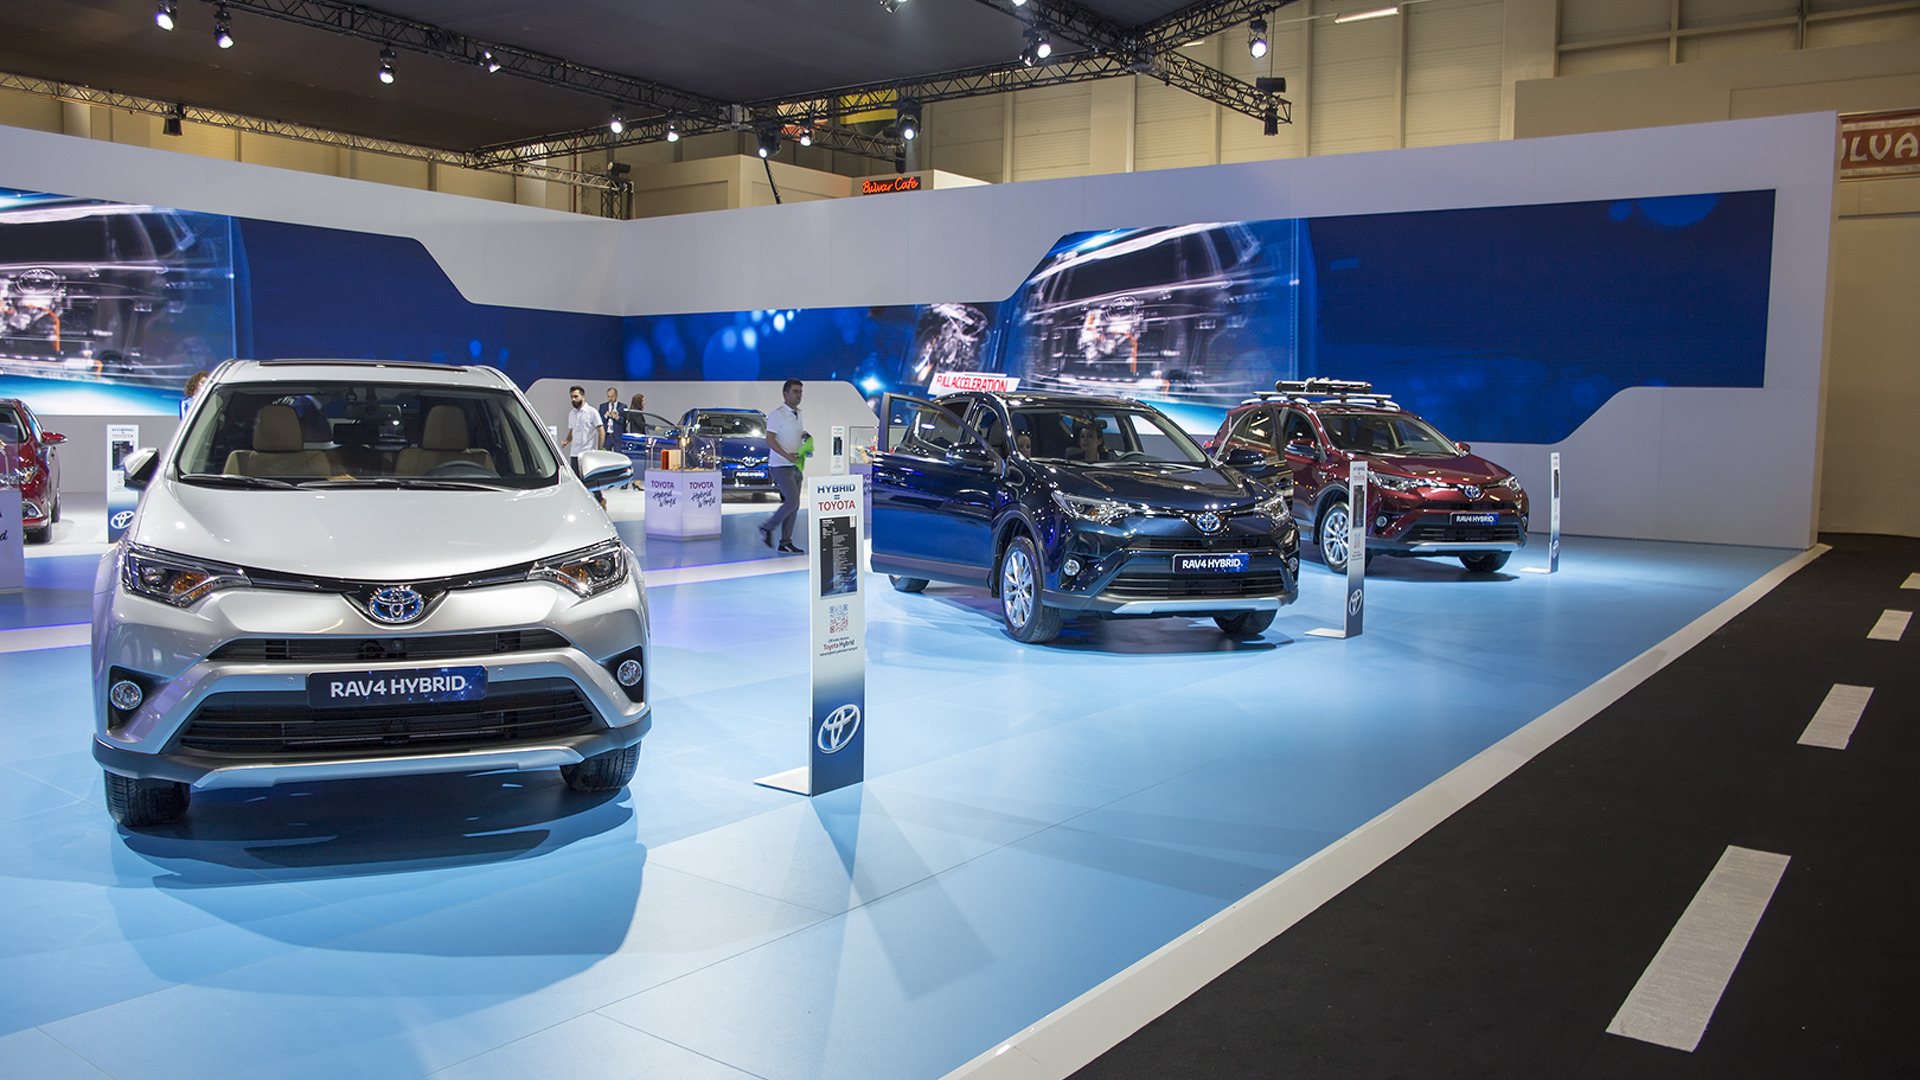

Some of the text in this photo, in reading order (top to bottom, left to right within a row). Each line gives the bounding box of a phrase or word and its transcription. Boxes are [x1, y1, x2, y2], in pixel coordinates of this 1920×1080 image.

[862, 180, 893, 194] Bulvar
[951, 377, 1009, 392] ACCELERATION
[651, 480, 675, 489] TOYOTA
[689, 481, 715, 490] TOYOTA
[817, 483, 856, 494] HYBRID
[818, 500, 856, 512] TOYOTA
[1182, 558, 1241, 569] RAV4 HYBRID
[823, 643, 839, 651] Toyota
[839, 639, 855, 648] Hybrid
[330, 675, 467, 698] RAV4 HYBRID
